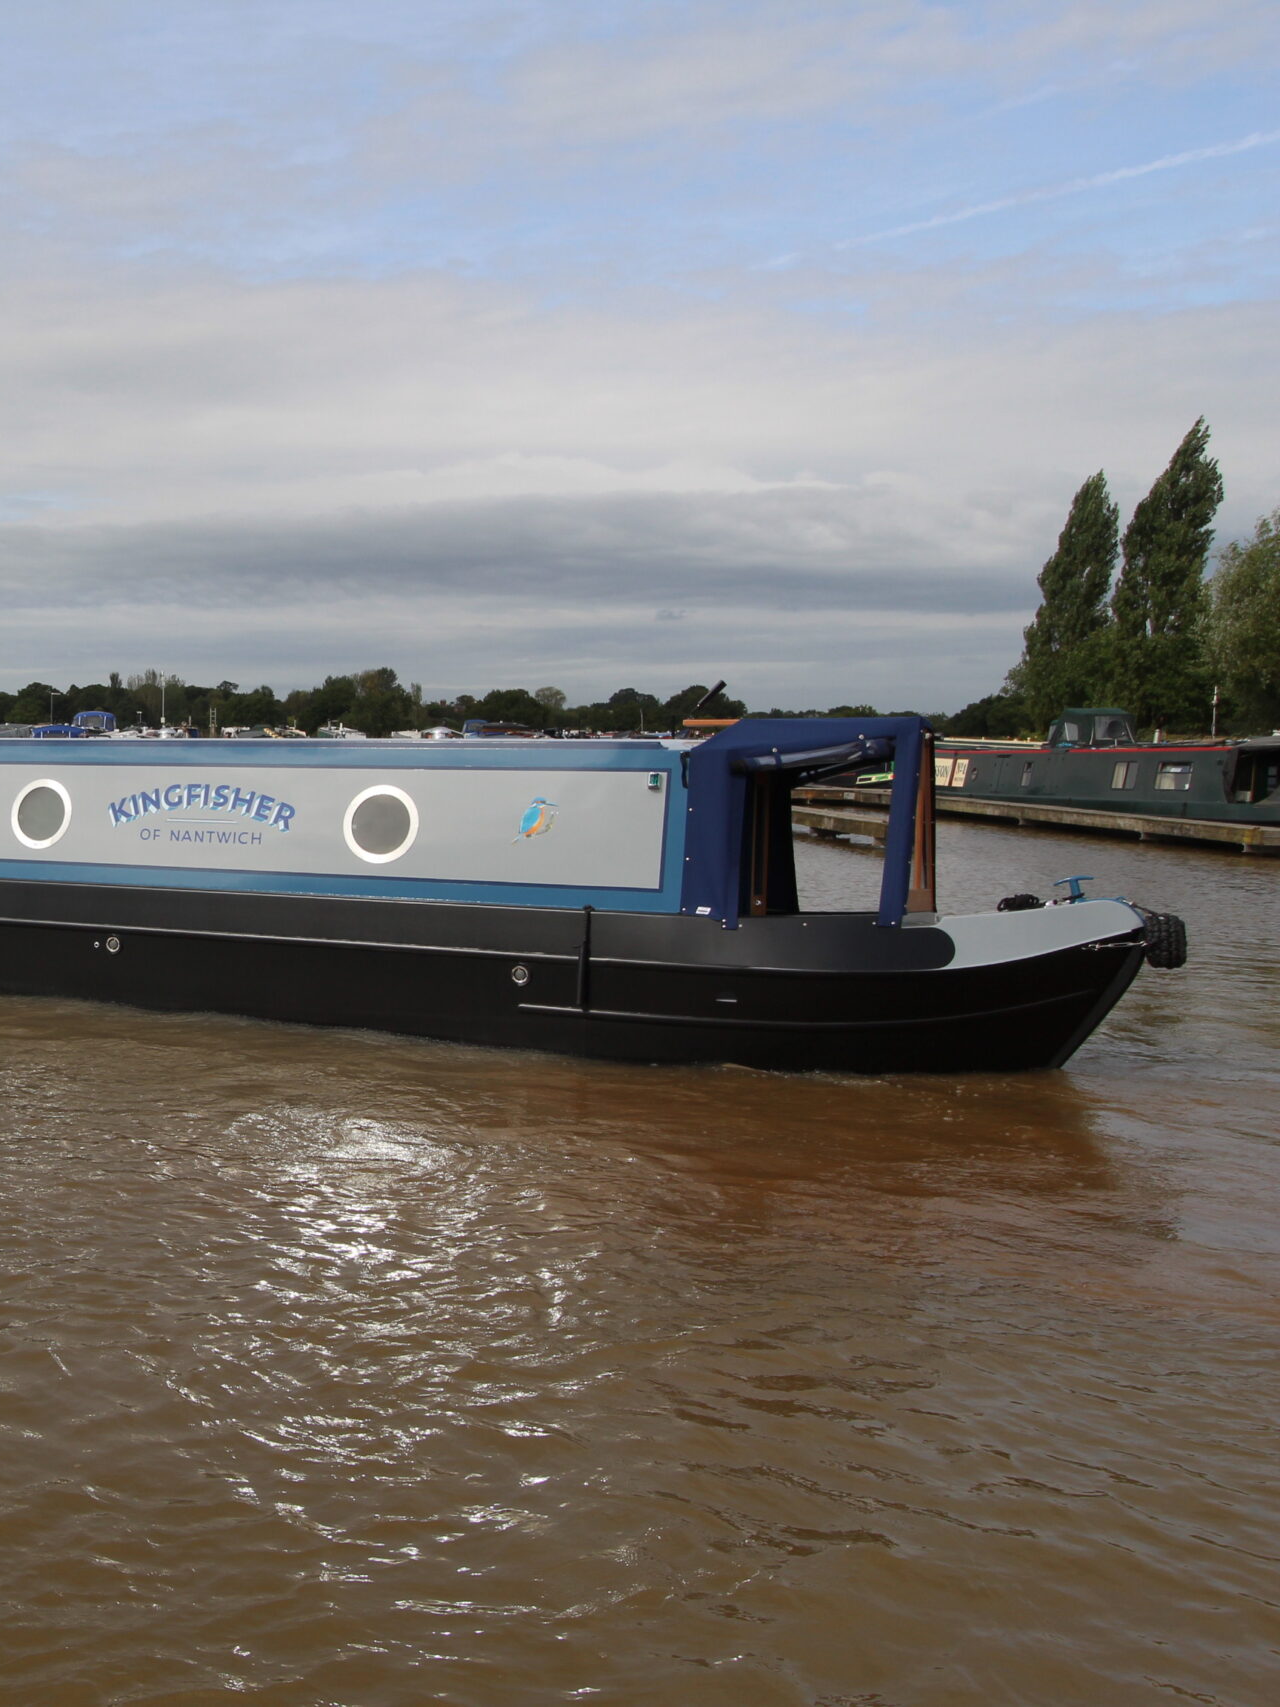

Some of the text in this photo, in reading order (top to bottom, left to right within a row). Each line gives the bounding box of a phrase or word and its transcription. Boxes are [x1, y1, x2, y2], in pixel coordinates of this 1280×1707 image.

[108, 783, 296, 832] KINGFISHER
[140, 828, 263, 845] OF NANTWICH
